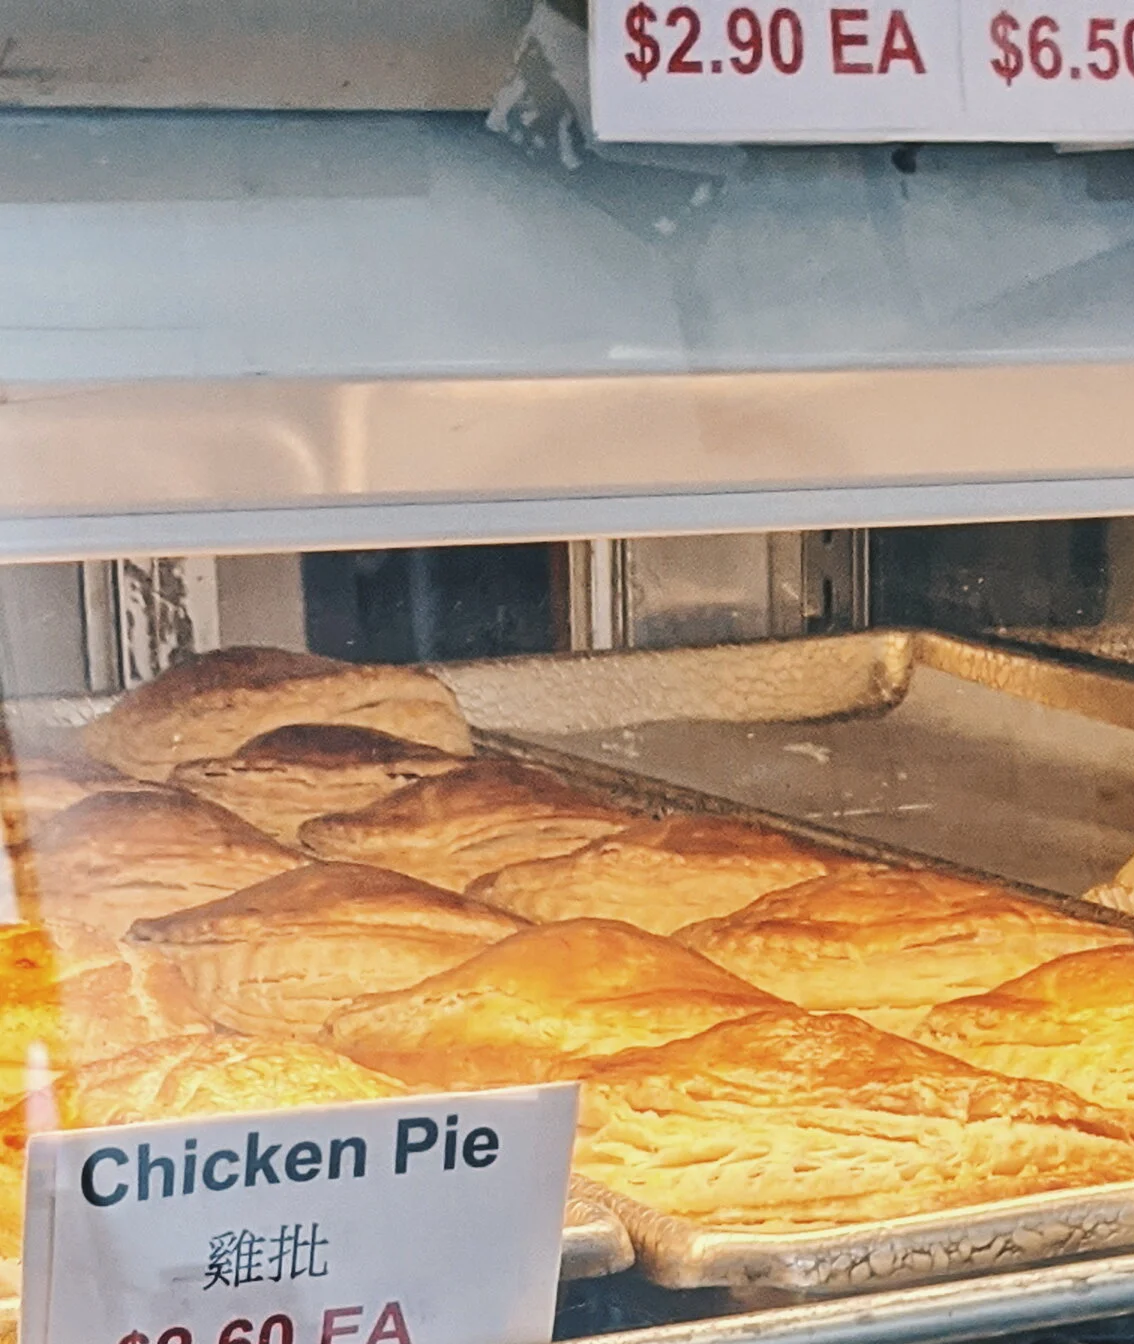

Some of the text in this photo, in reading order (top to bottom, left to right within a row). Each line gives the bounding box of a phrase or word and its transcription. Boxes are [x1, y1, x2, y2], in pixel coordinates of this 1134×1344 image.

[624, 3, 926, 82] $2.90 EA
[81, 1114, 500, 1208] Chicken Pie
[203, 1222, 329, 1291] 雞批
